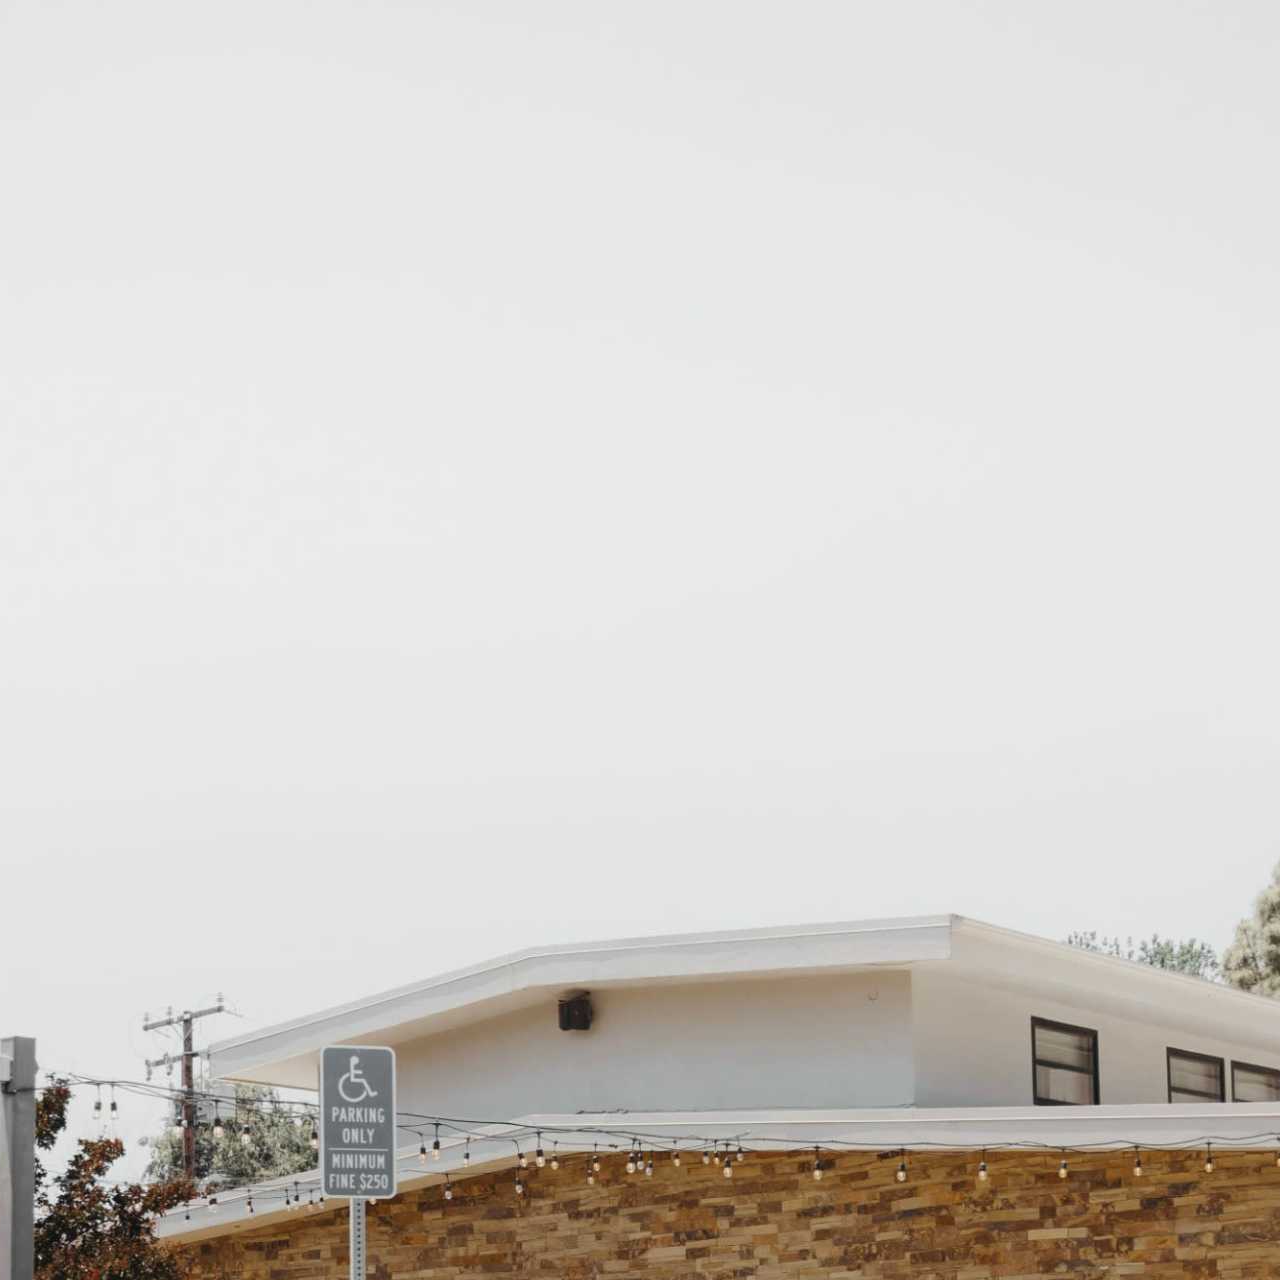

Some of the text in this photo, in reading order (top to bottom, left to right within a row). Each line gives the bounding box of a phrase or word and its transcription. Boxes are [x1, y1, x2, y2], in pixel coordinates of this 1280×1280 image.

[331, 1106, 386, 1124] PARKING
[342, 1128, 375, 1144] ONLY
[332, 1153, 386, 1169] MINIMUM
[329, 1172, 390, 1191] FINE $250
